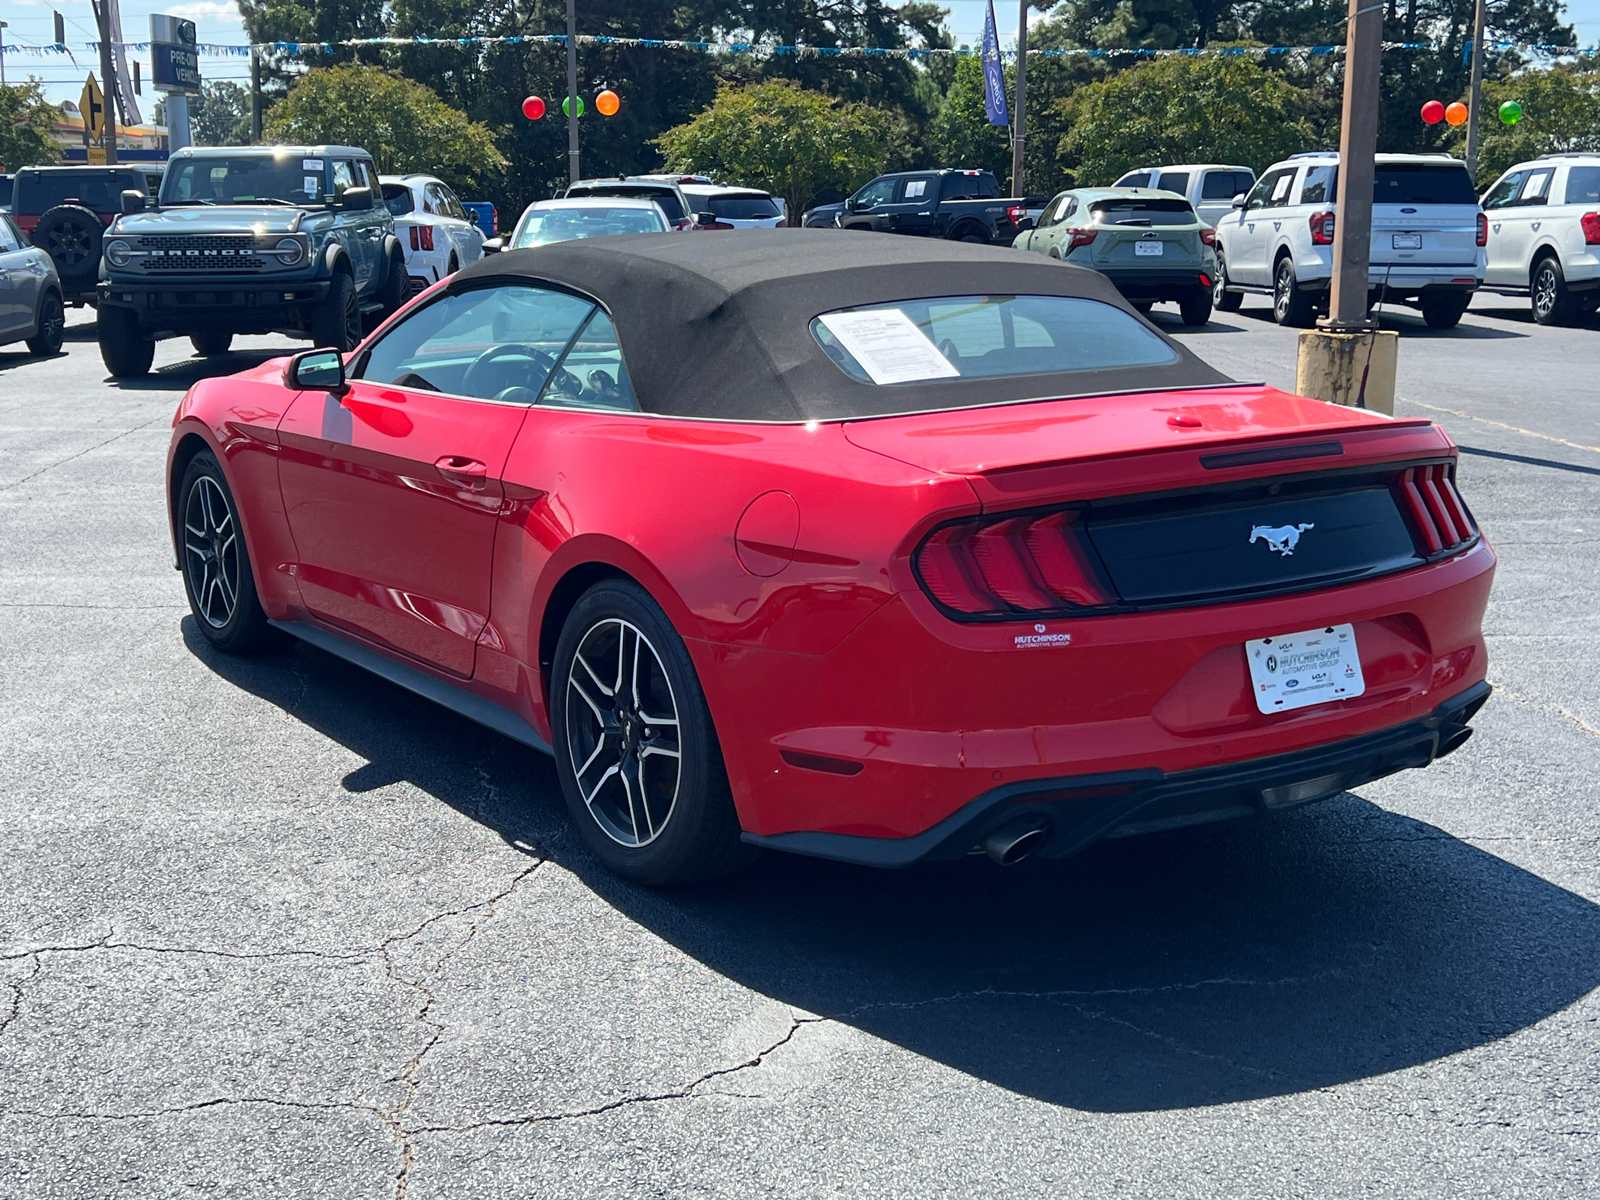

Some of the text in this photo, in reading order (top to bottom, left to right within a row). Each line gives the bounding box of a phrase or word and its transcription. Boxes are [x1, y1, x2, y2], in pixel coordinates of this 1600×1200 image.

[1014, 634, 1071, 643] HUTCHINSON
[1280, 647, 1341, 668] HUTCHINSON
[1282, 659, 1339, 676] AUTOMOTIVE GROUP
